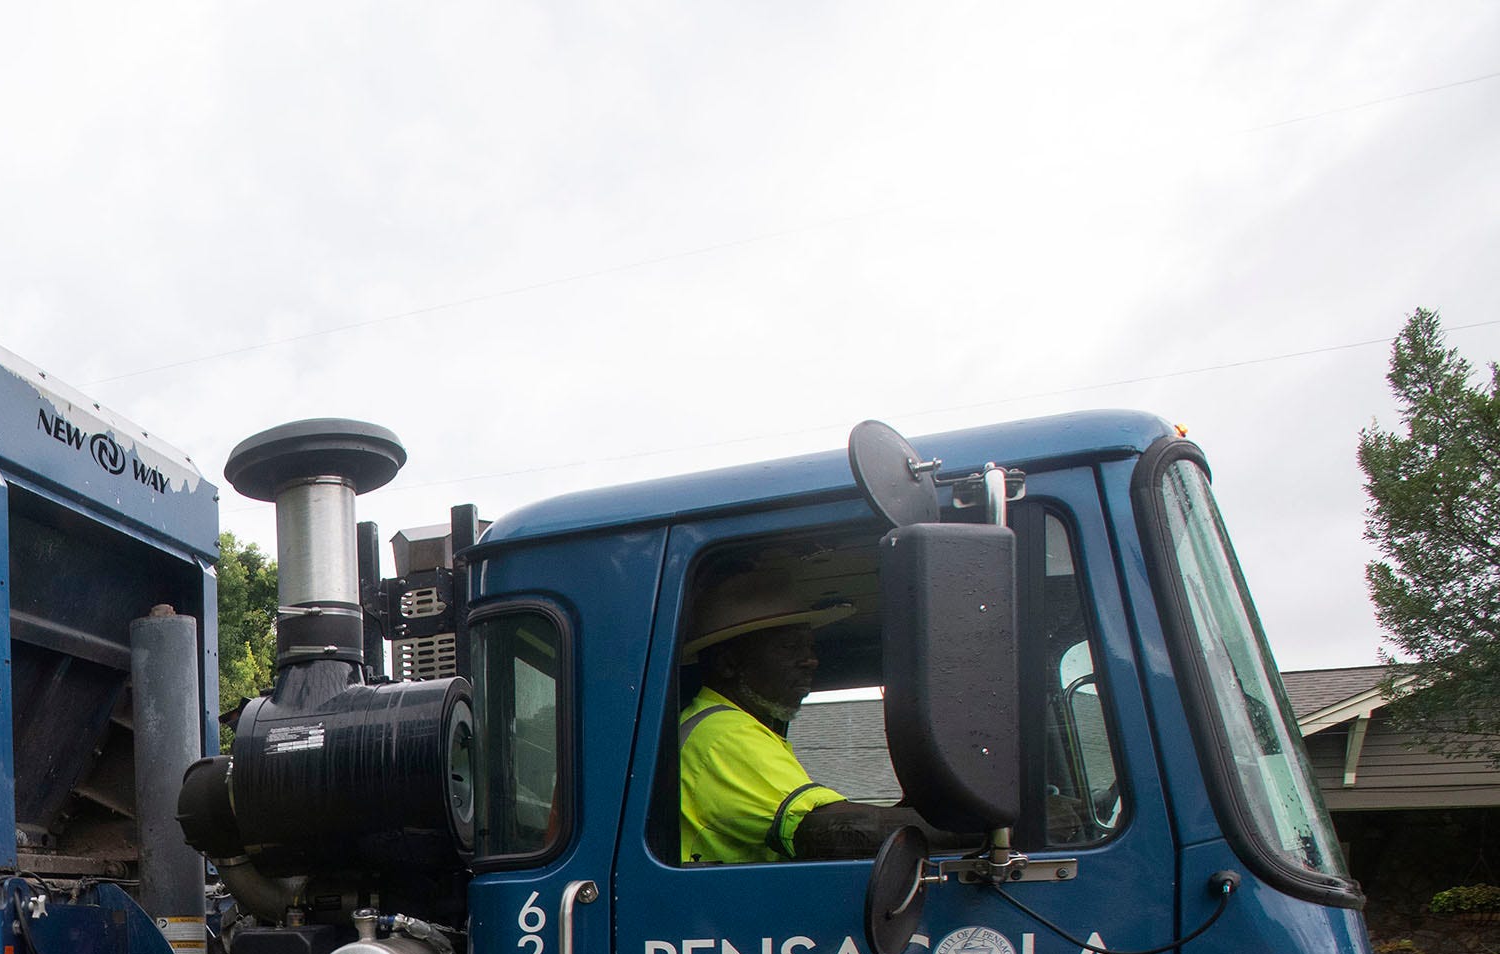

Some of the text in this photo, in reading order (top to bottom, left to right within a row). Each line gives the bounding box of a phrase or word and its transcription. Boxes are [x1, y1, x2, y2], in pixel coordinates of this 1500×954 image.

[37, 408, 87, 450] NEW
[132, 458, 170, 494] WAY
[957, 930, 970, 939] OF
